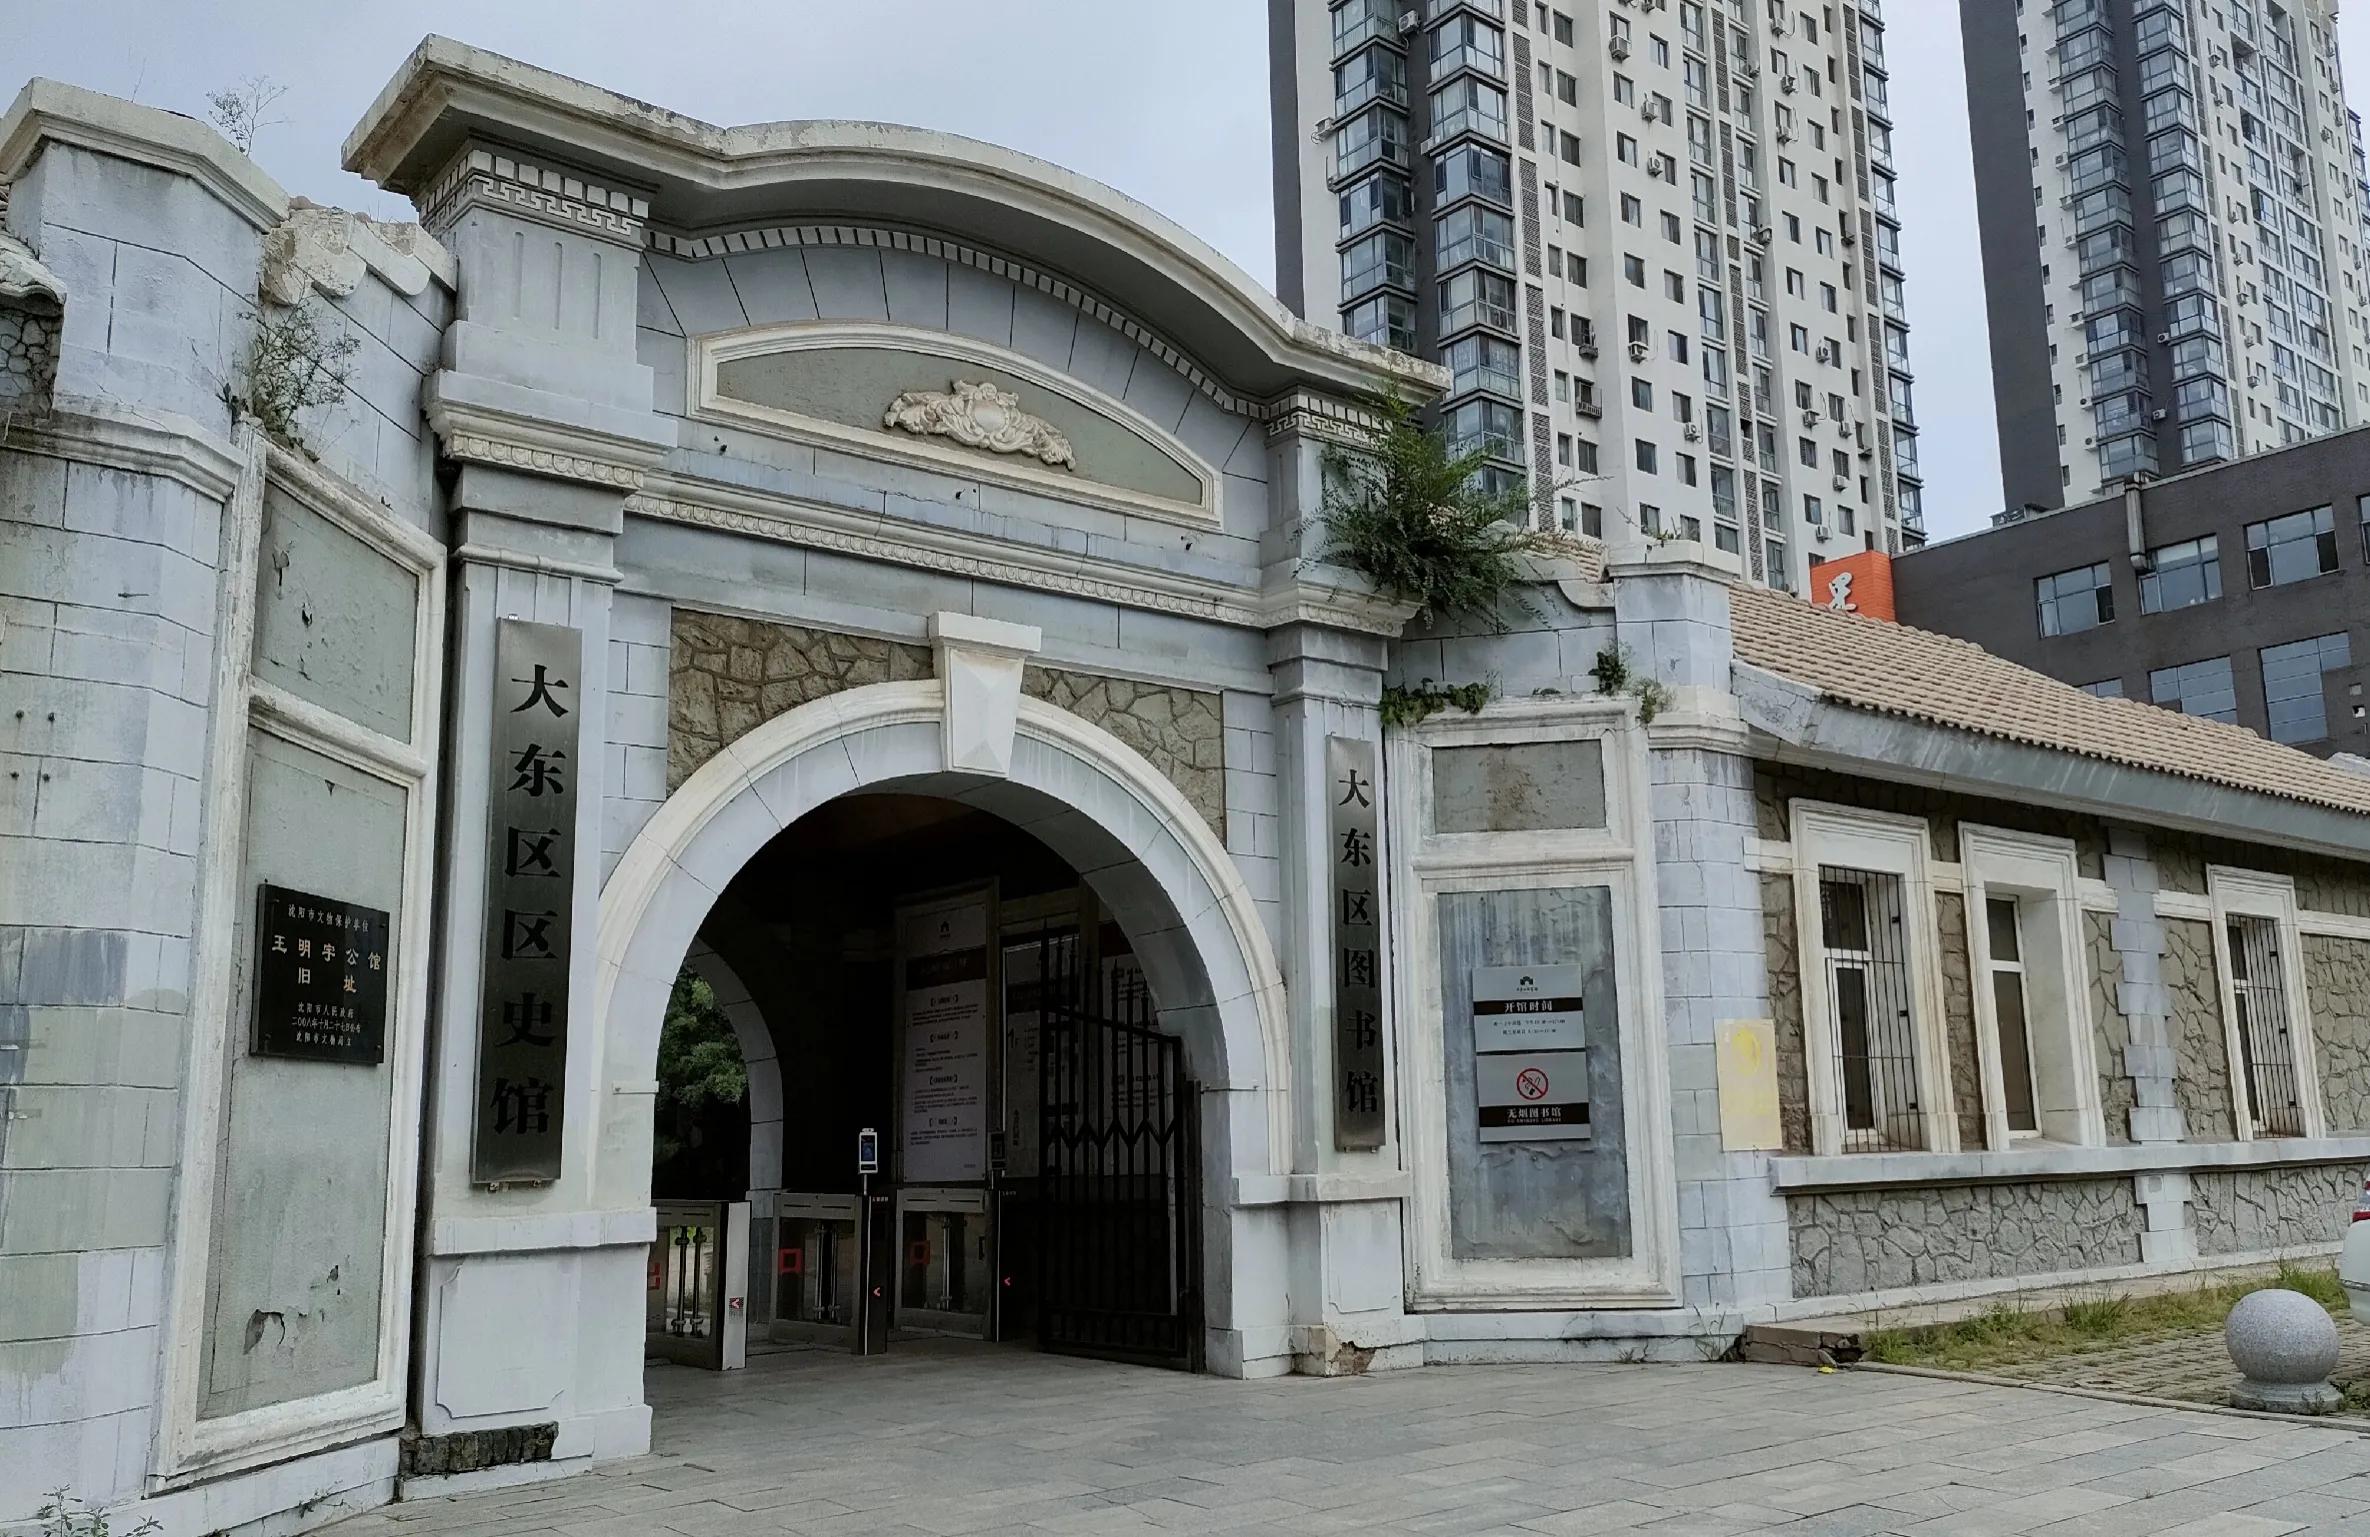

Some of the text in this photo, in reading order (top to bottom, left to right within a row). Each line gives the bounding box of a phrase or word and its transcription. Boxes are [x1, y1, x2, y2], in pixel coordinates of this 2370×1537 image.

[490, 664, 568, 1134] 大东区区史馆
[288, 903, 369, 933] 沈阳市文物保护单位
[272, 934, 381, 970] 王明宇公馆
[1338, 769, 1378, 1112] 大东区图书馆
[298, 967, 357, 993] 旧址
[1505, 1000, 1553, 1013] 开馆时间
[1507, 1107, 1562, 1119] 无烟图书馆
